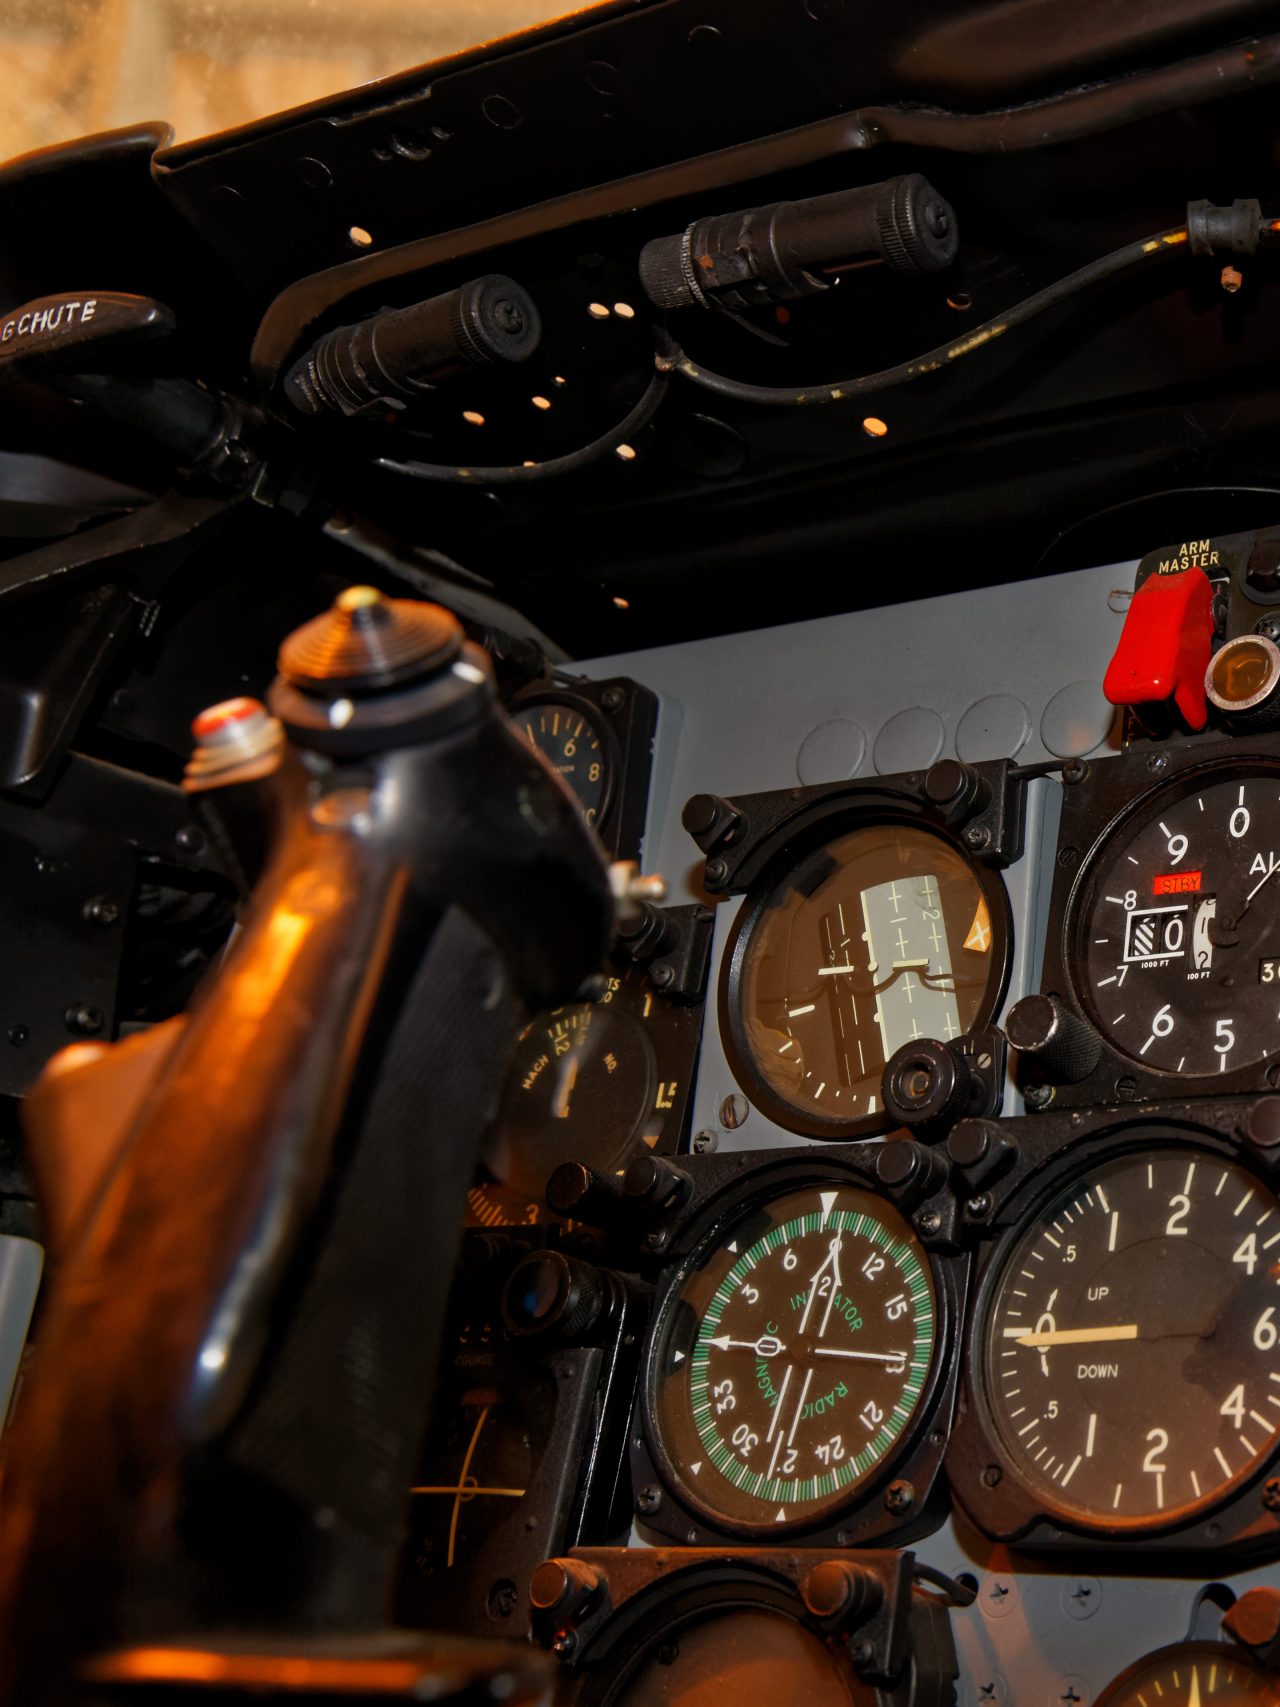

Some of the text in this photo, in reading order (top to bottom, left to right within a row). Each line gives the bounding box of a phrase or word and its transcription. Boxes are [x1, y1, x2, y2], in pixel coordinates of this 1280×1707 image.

[18, 300, 97, 334] CHUTE
[1179, 539, 1210, 556] ARM
[1159, 552, 1219, 574] MASTER
[563, 738, 576, 757] 6
[588, 763, 600, 782] 8
[1229, 807, 1250, 838] 0
[1167, 835, 1188, 865] 9
[1162, 876, 1200, 894] STBY
[1123, 889, 1137, 911] 8
[923, 909, 941, 921] 2
[1163, 917, 1184, 951] 0
[1113, 965, 1129, 987] 7
[1141, 959, 1169, 969] 1000 FT
[1187, 971, 1211, 980] 100 FT
[1152, 1004, 1174, 1037] 6
[1214, 1020, 1235, 1052] 5
[522, 1054, 549, 1090] MACH
[1166, 1194, 1191, 1235] 2
[1108, 1212, 1118, 1252] 1
[782, 1249, 797, 1271] 6
[862, 1252, 885, 1280] 12
[1062, 1244, 1077, 1263] .5
[1233, 1233, 1258, 1275] 4
[741, 1285, 759, 1304] 3
[817, 1276, 831, 1297] 2
[1087, 1286, 1109, 1301] UP
[790, 1290, 863, 1333] INATOR
[885, 1294, 907, 1320] 15
[1253, 1307, 1277, 1350] 6
[1077, 1363, 1119, 1379] DOWN
[714, 1379, 736, 1415] 33
[1043, 1401, 1058, 1419] .5
[1220, 1384, 1245, 1429] 4
[860, 1400, 883, 1430] 21
[732, 1424, 758, 1457] 30
[815, 1434, 845, 1466] 24
[1086, 1414, 1097, 1458] 1
[1143, 1428, 1169, 1472] 2
